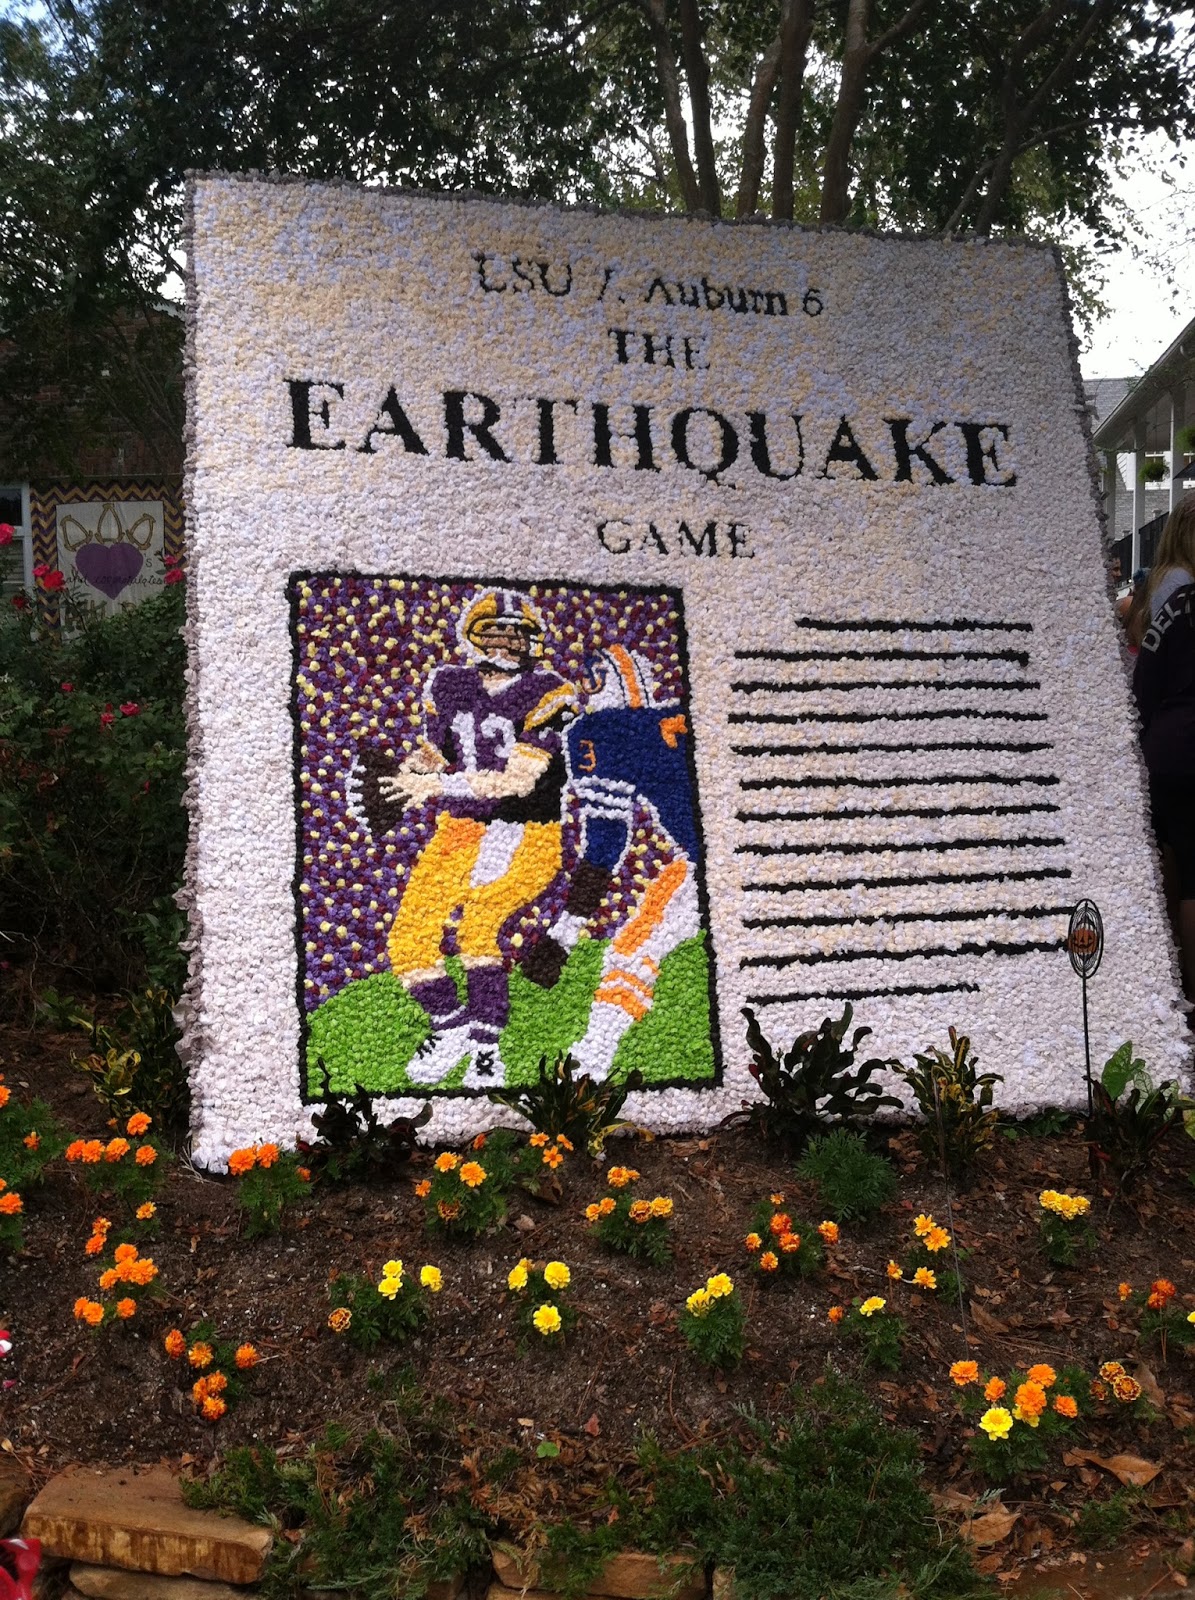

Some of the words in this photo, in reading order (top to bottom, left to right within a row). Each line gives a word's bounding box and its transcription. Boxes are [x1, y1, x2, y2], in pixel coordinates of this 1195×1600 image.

[471, 252, 572, 297] LSU
[644, 277, 788, 317] Auburn
[802, 288, 824, 317] 6
[607, 328, 711, 370] THE
[284, 378, 1017, 489] EARTHQUAKE
[596, 519, 755, 558] GAME
